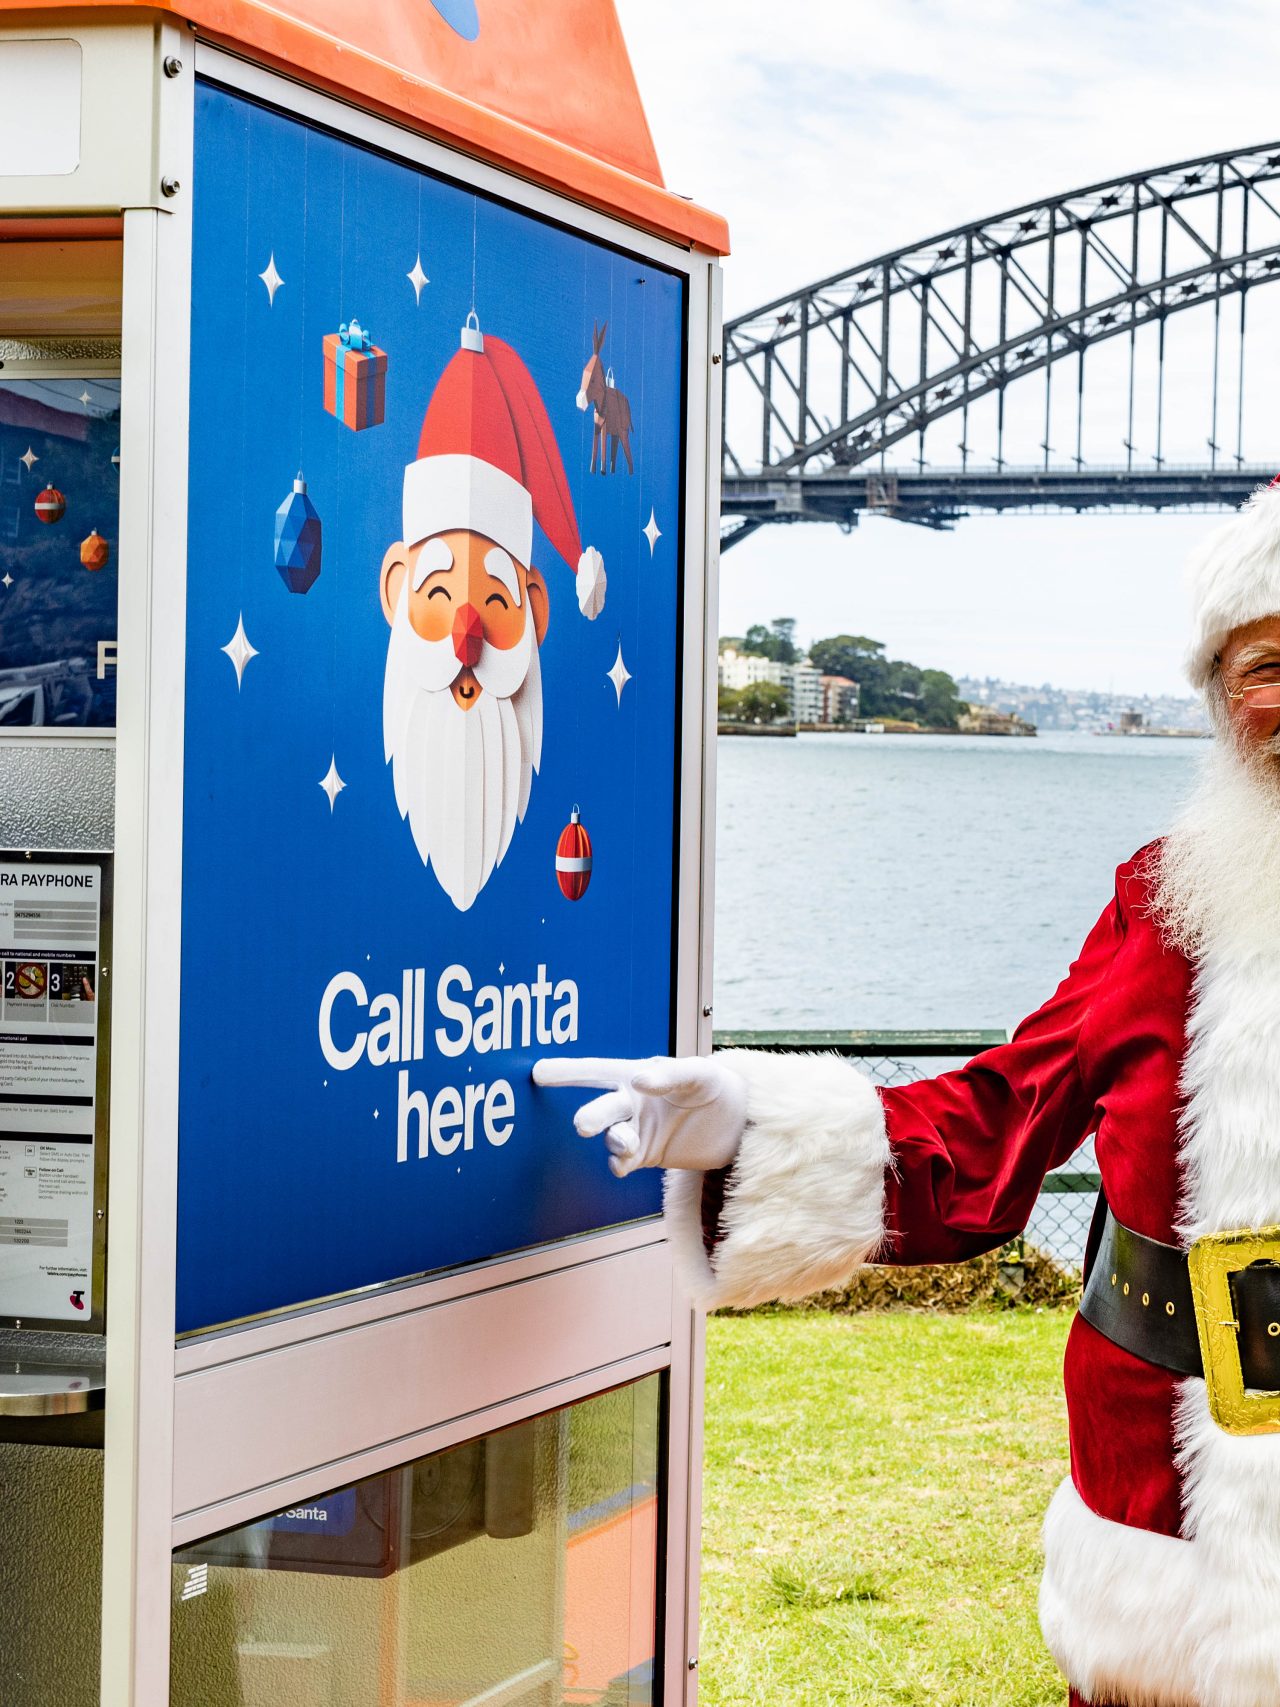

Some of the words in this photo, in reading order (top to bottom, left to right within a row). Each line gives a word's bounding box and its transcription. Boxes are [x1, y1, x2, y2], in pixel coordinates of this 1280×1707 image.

[22, 874, 93, 888] PAYPHONE
[6, 972, 15, 990] 2
[51, 974, 60, 992] 3
[318, 968, 426, 1070] Call
[435, 964, 579, 1058] Santa
[397, 1070, 515, 1163] here
